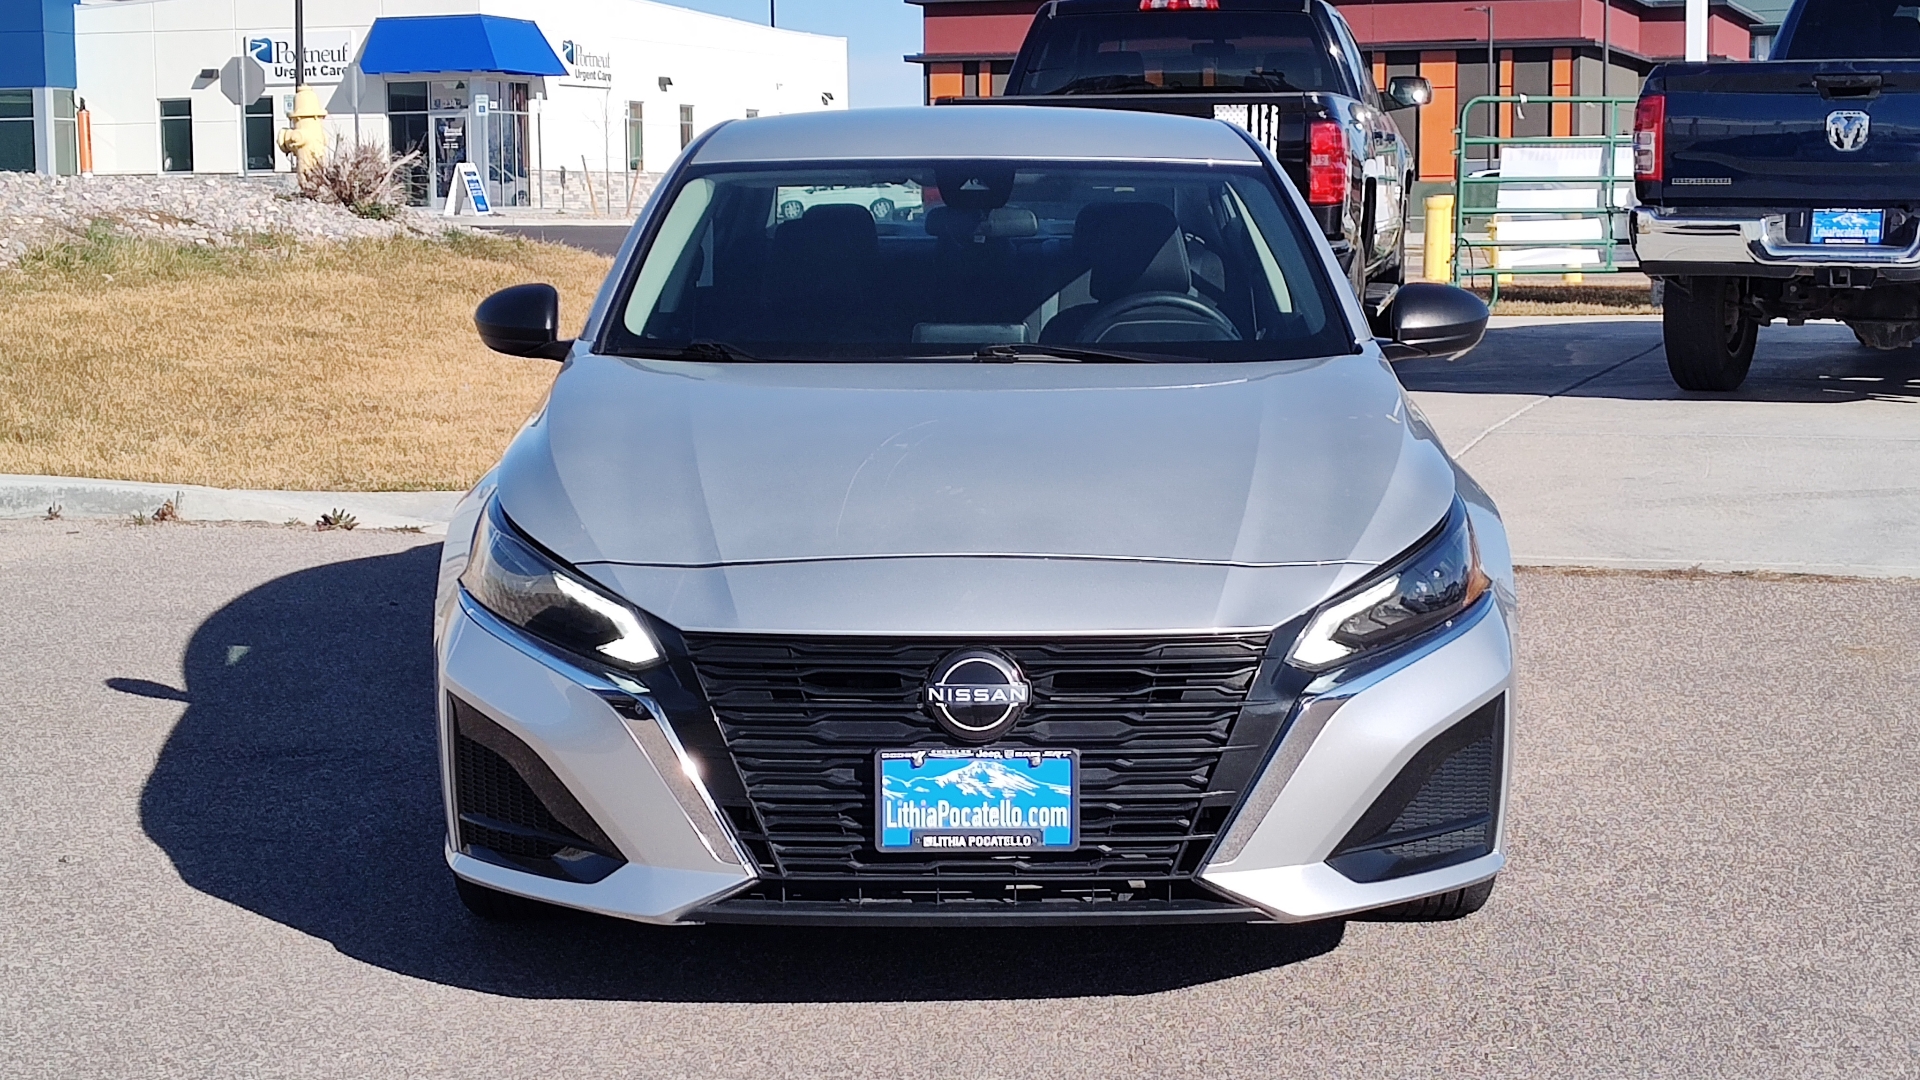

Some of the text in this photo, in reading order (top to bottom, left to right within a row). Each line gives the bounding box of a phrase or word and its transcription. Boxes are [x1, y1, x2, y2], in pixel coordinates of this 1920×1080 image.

[274, 41, 348, 64] Potneuf
[274, 66, 317, 79] Urgnt
[575, 69, 596, 81] Urgent
[927, 687, 1026, 702] NISSAN
[886, 799, 1068, 829] LithiaPocatello.com
[933, 836, 1032, 848] LITHIA POCATELLO
